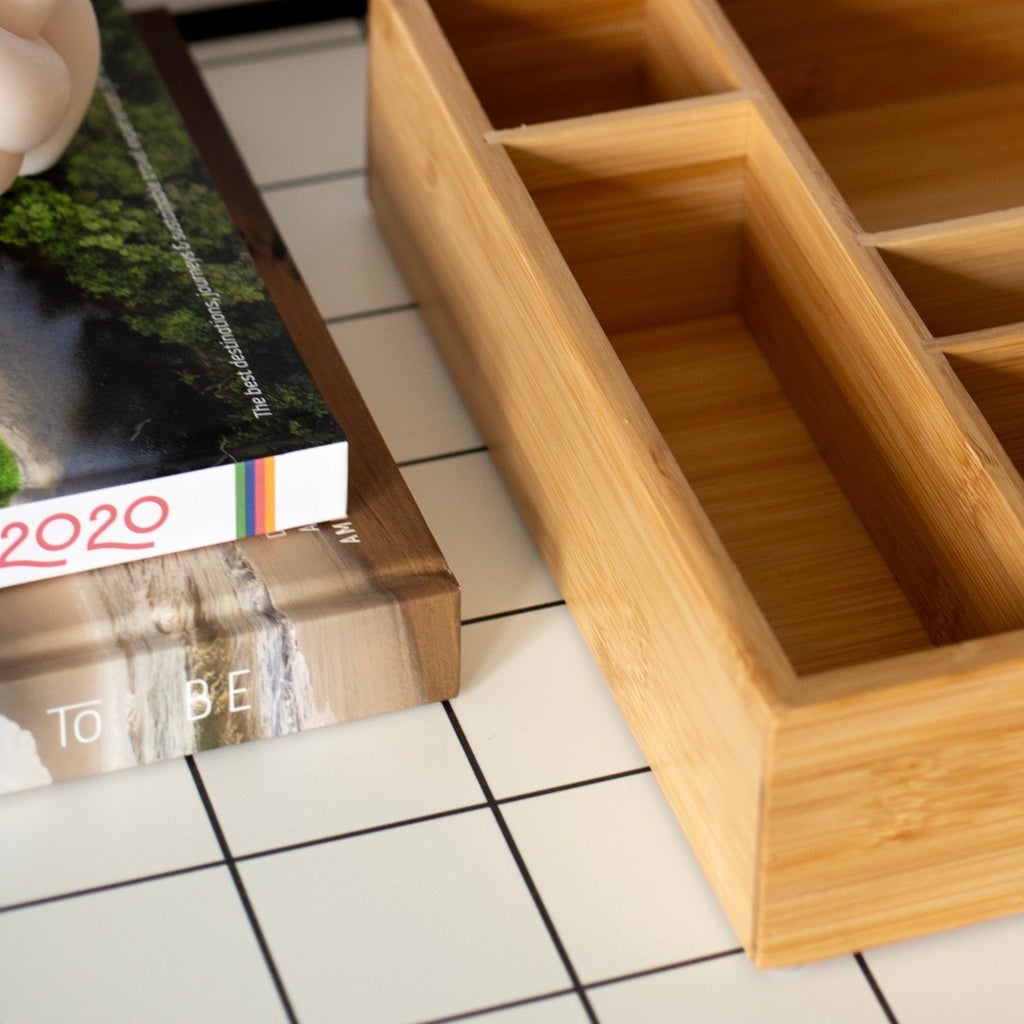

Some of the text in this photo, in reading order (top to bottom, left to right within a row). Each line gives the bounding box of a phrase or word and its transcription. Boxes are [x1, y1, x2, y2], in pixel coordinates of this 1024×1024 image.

[204, 296, 249, 369] destinations,
[236, 368, 262, 396] best
[252, 395, 273, 419] The
[0, 495, 169, 569] 2020
